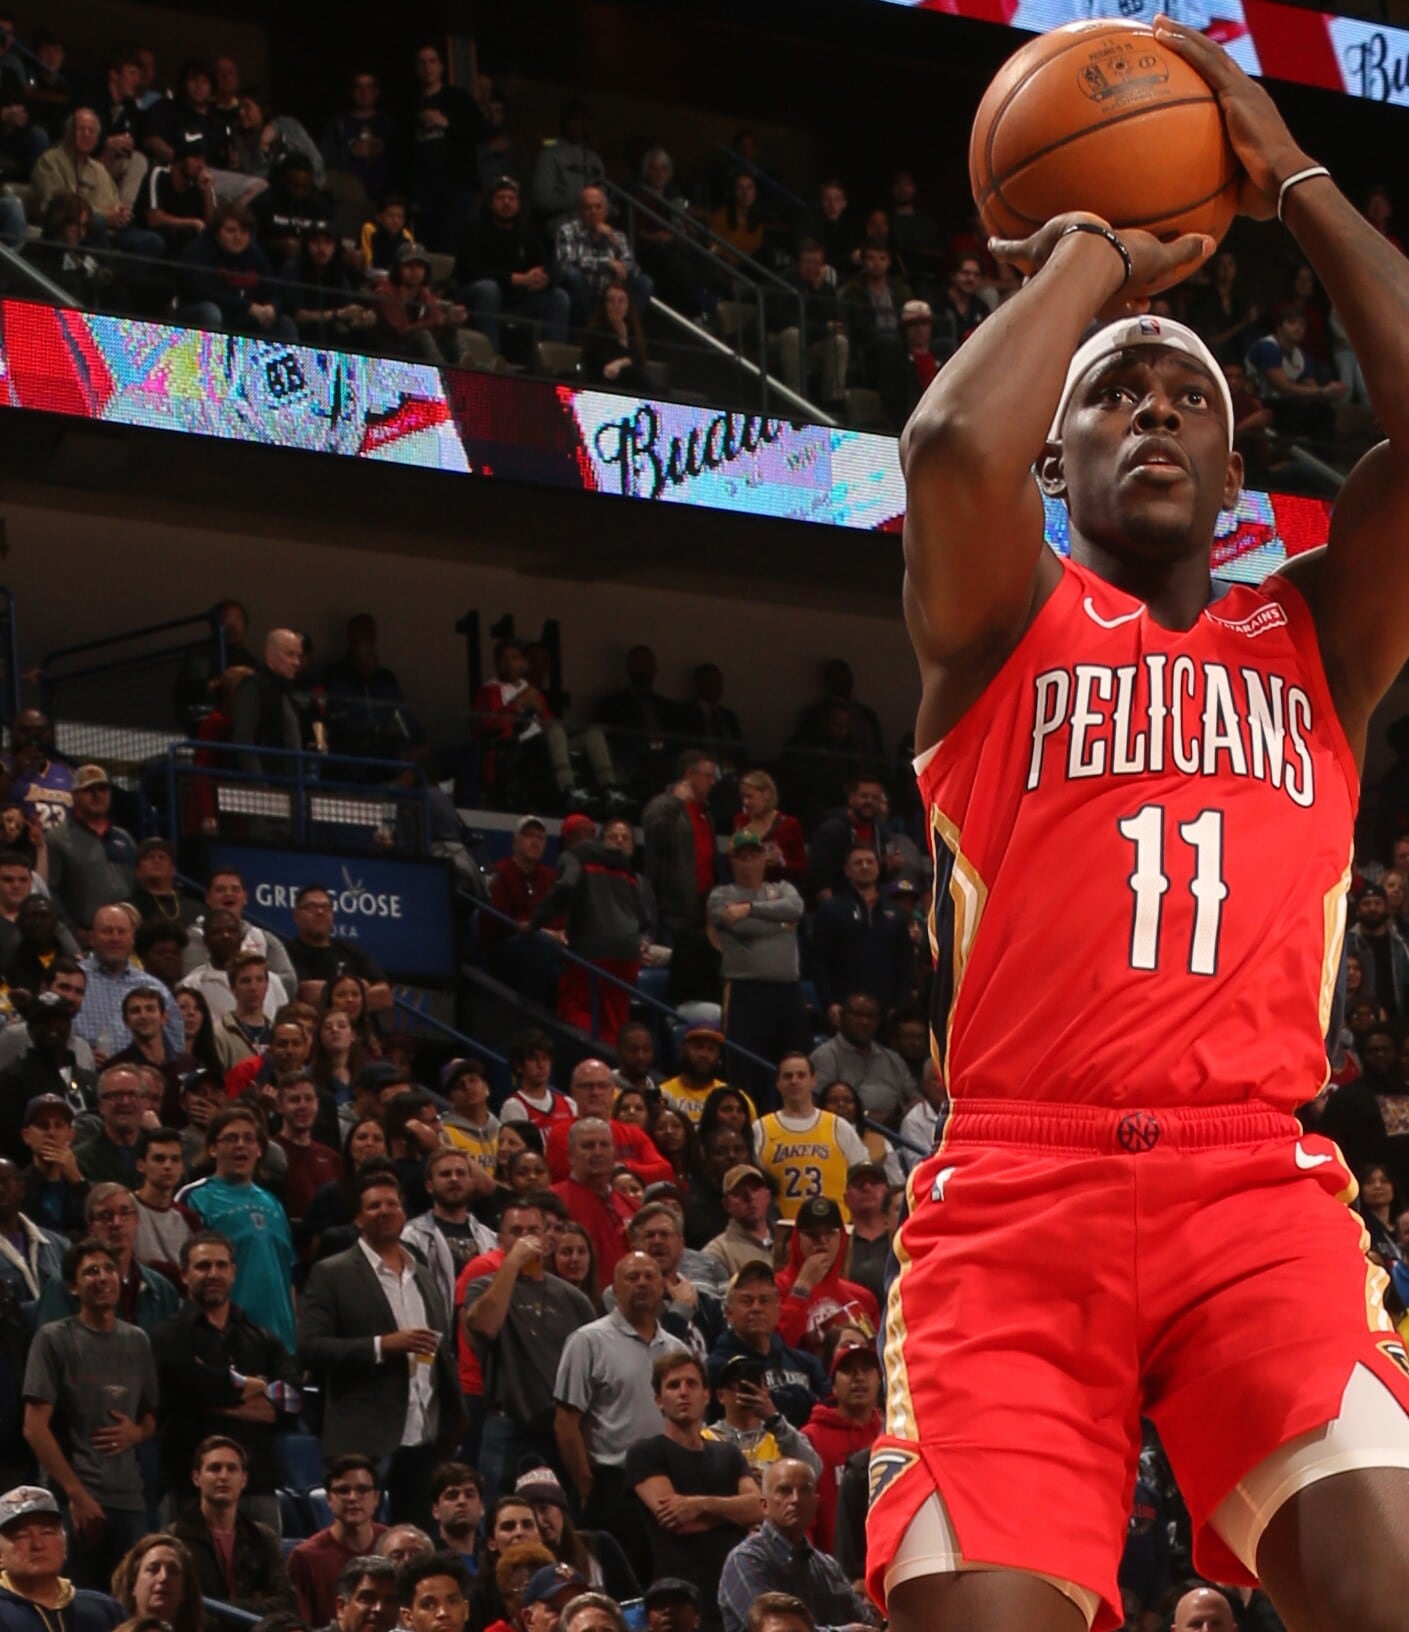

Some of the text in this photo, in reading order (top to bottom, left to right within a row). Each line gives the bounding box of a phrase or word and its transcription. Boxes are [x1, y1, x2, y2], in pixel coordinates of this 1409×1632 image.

[596, 405, 806, 501] Budw
[1027, 652, 1316, 809] PELICANS
[256, 883, 302, 910] GRE
[1117, 803, 1230, 977] 11
[773, 1143, 830, 1165] LAKERS
[784, 1166, 823, 1201] 23
